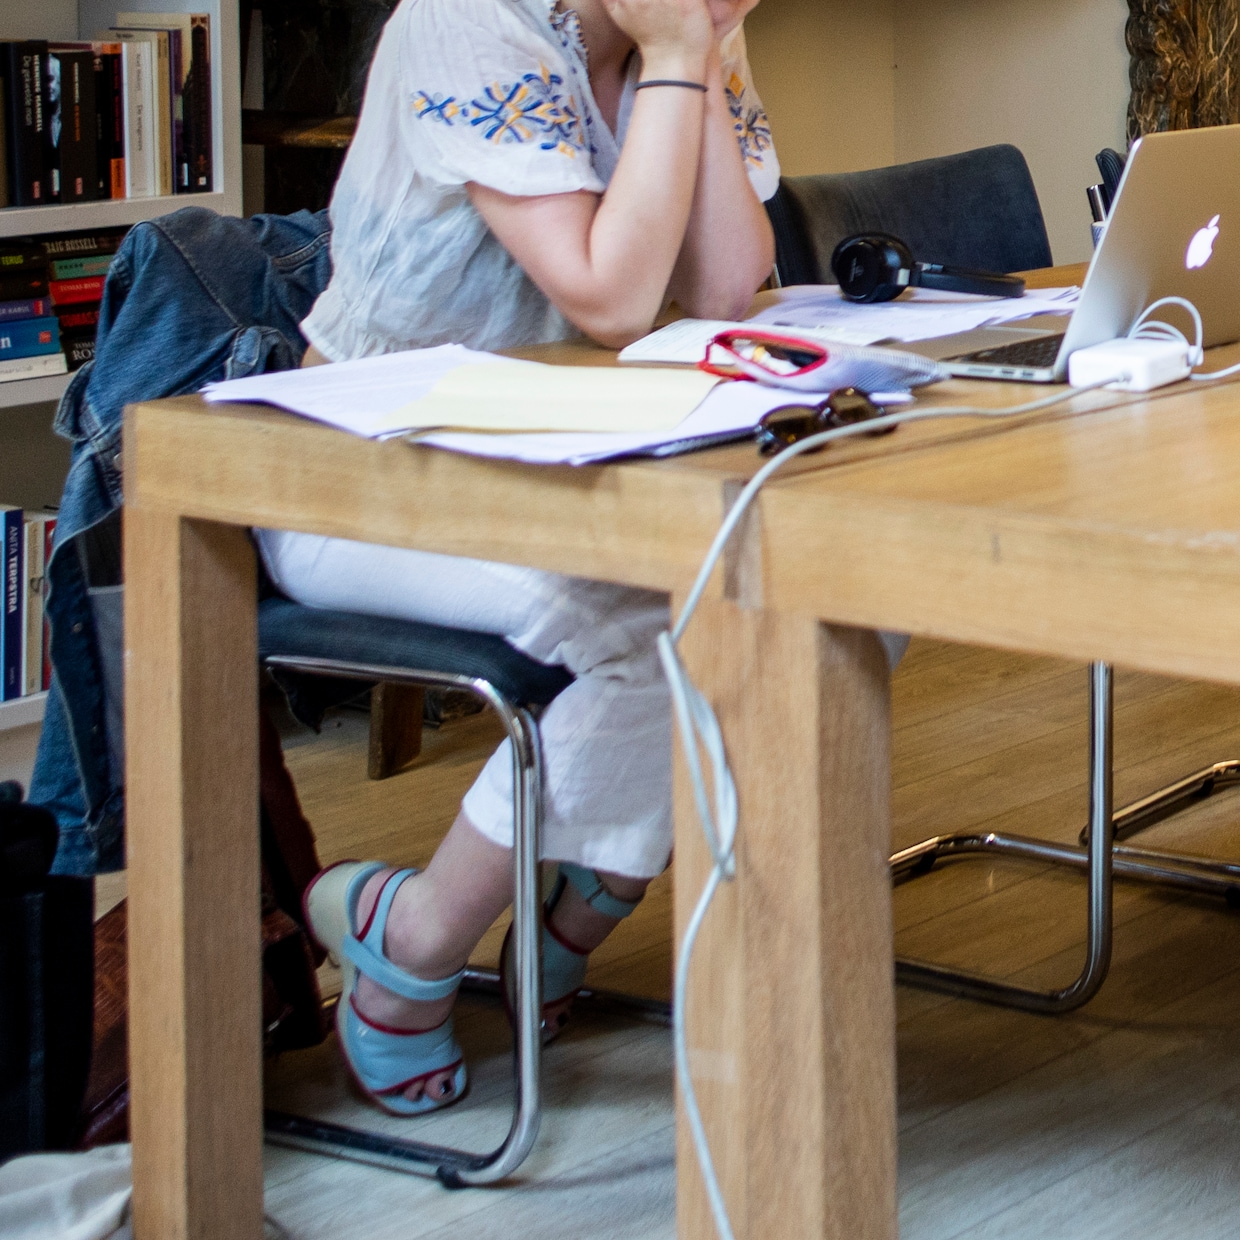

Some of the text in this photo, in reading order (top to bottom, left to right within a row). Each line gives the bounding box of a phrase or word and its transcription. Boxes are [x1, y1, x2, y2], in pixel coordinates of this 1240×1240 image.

[72, 348, 94, 360] ROS
[8, 526, 18, 614] ANITA TERPSTRA
